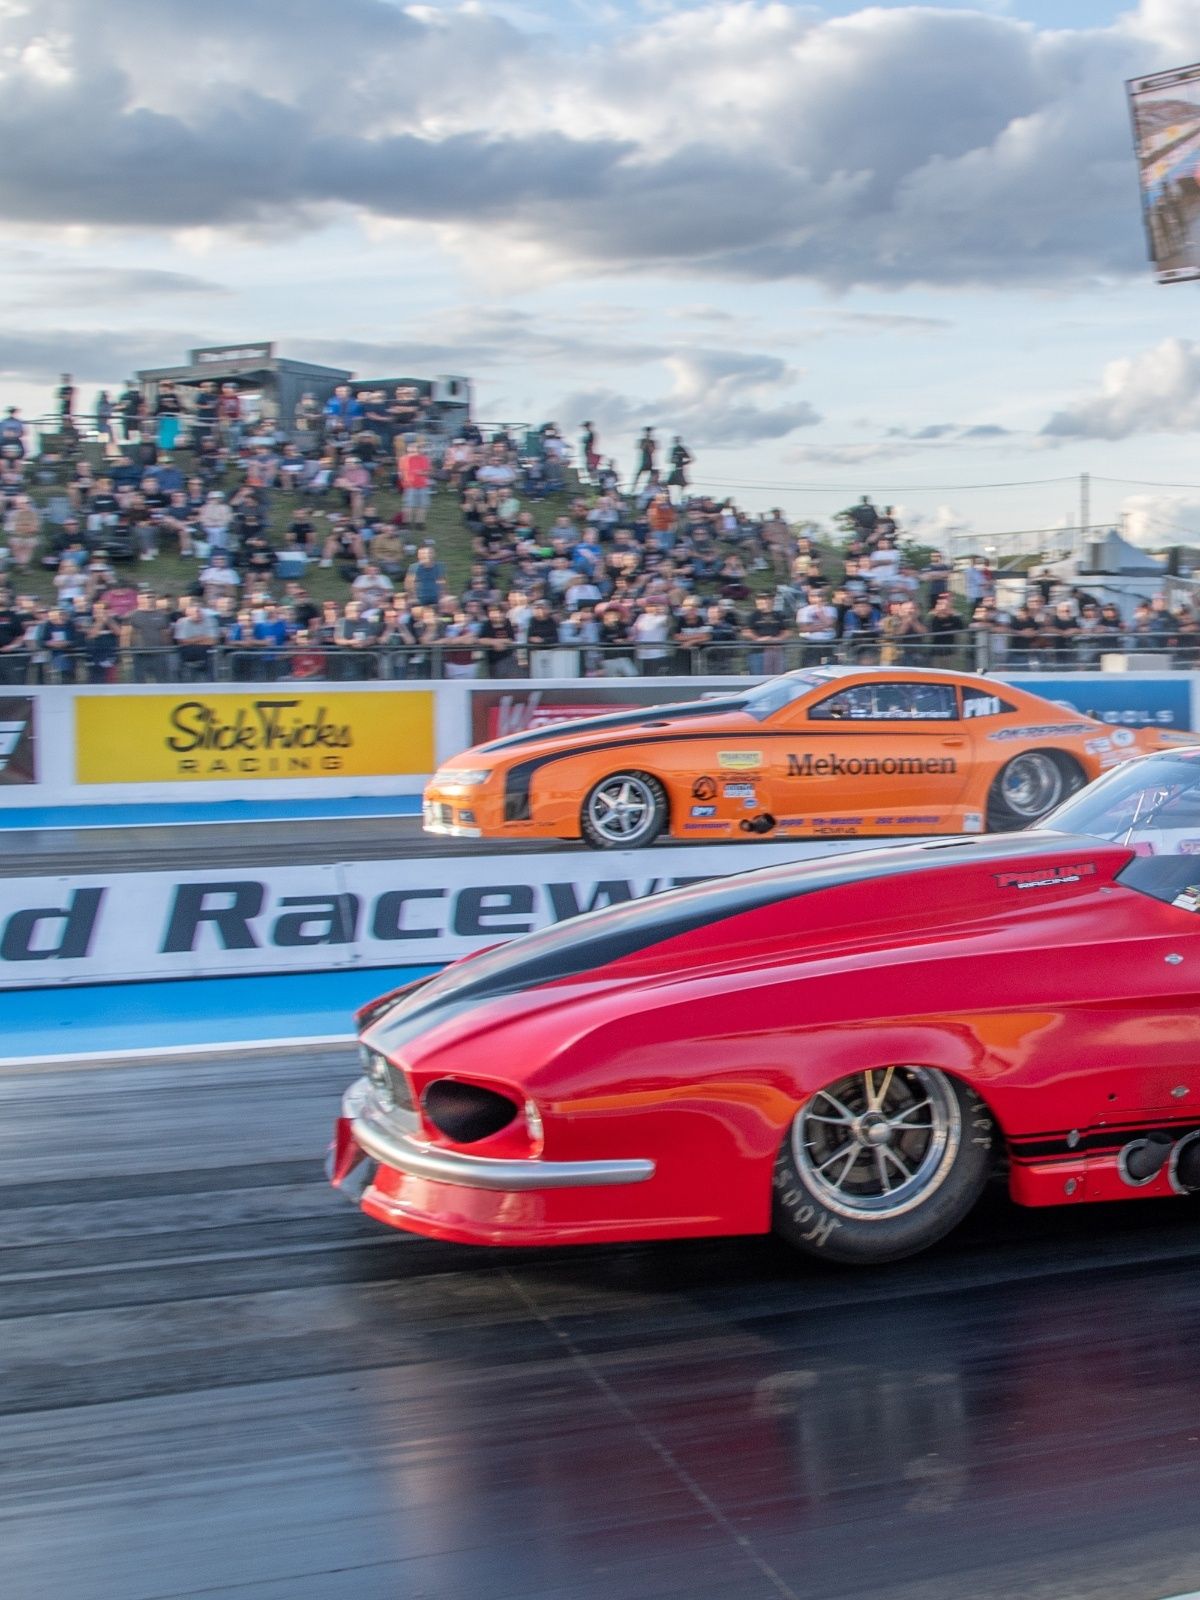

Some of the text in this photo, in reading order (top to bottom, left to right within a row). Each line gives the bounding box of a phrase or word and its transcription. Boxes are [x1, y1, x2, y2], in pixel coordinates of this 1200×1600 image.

[164, 699, 353, 752] Slick Tricks
[1103, 710, 1174, 724] OOLS
[179, 755, 344, 775] RACING
[786, 753, 957, 777] Mekonomen
[1017, 873, 1081, 889] RACING
[158, 875, 728, 954] Racew
